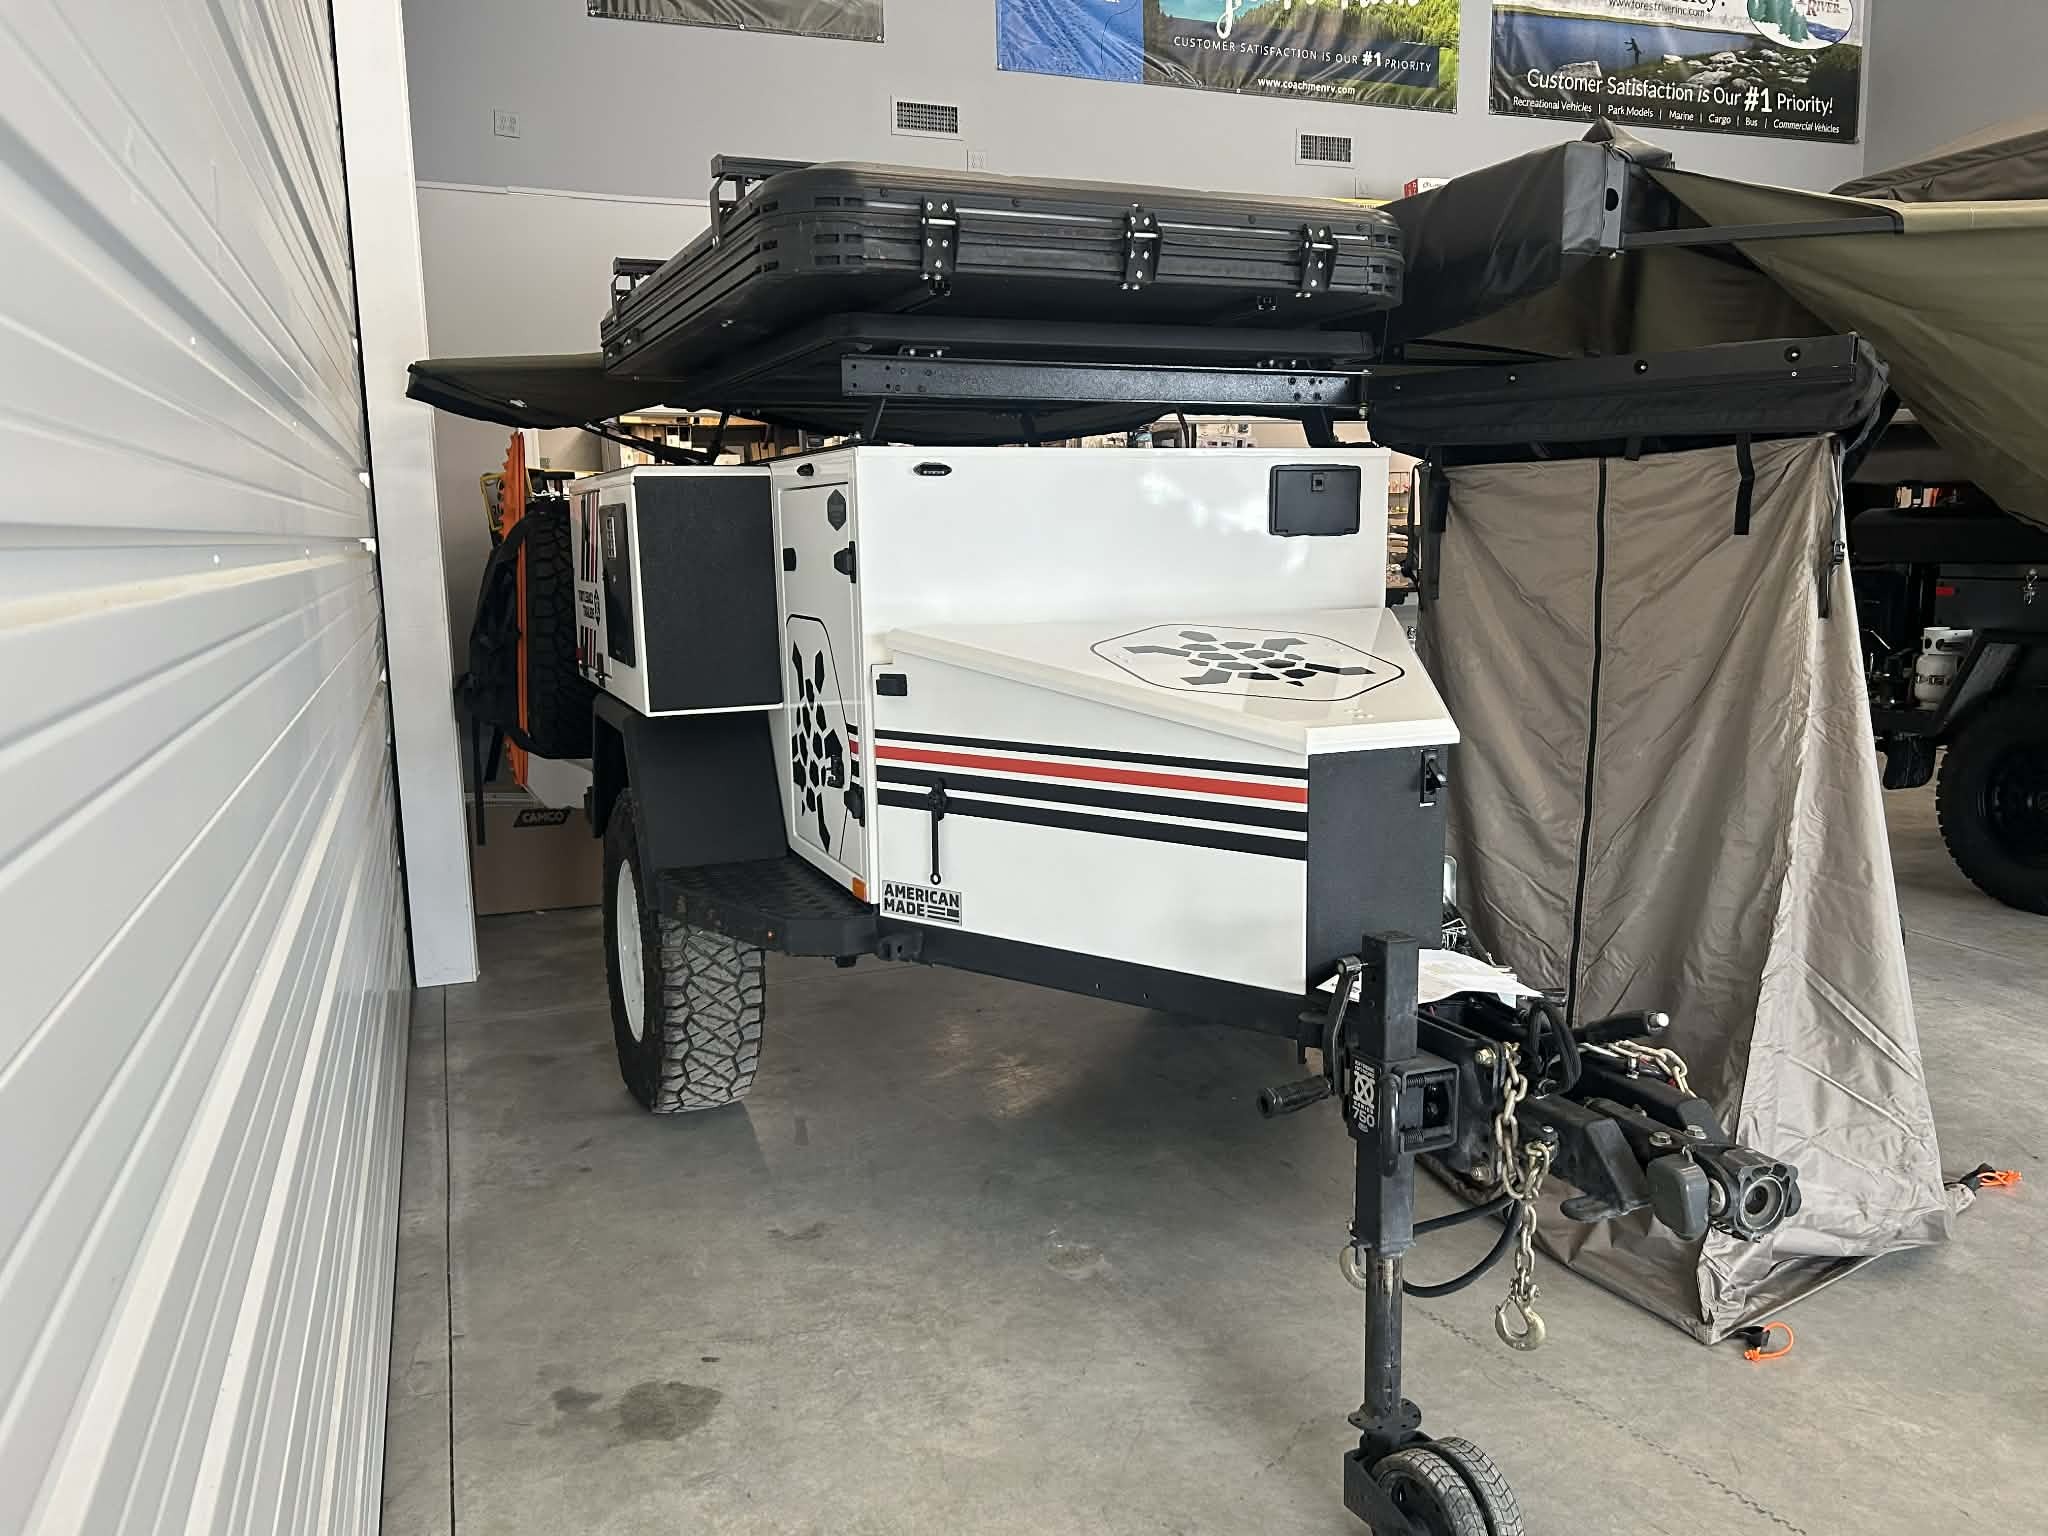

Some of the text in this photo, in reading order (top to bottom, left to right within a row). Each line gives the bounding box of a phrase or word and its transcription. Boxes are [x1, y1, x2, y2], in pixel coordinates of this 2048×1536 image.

[1174, 36, 1431, 73] CUSTOMER SATISFACTION IS OUR #1 PRIORITY
[1257, 78, 1356, 95] www.coachmenrv.com
[1527, 68, 1833, 117] Customer Satisfaction is Our #1 Priority!
[1513, 96, 1840, 134] Recreational Vehicles Park Models Marine Cargo Bus Commercial Vehicles
[884, 883, 960, 908] AMERICAN
[884, 897, 925, 917] MADE
[1352, 1104, 1375, 1128] 750
